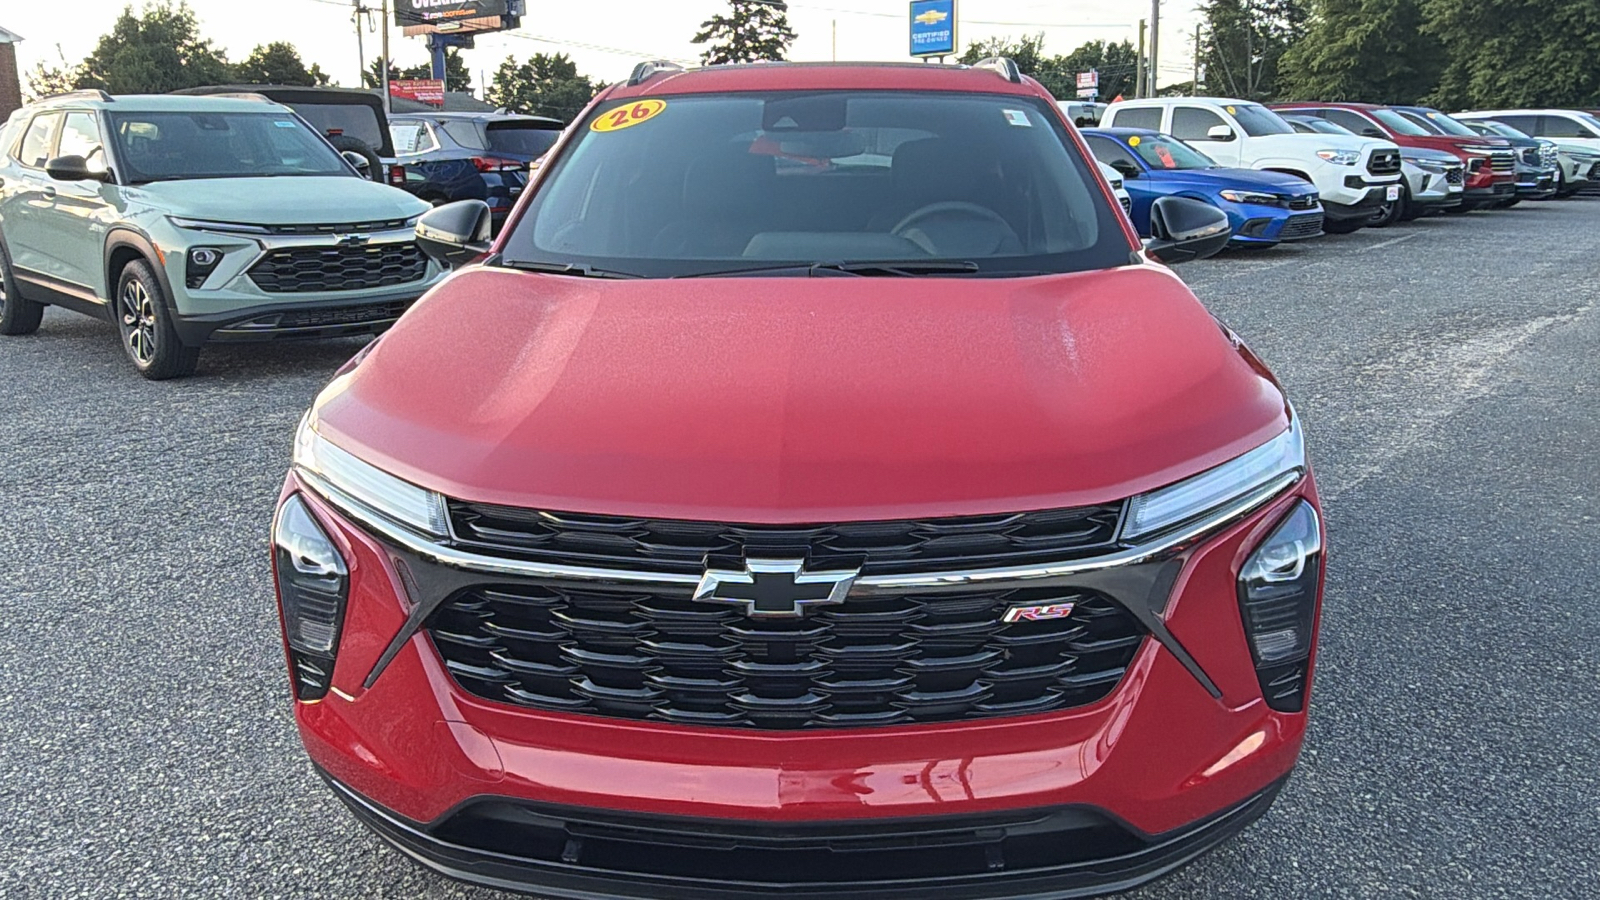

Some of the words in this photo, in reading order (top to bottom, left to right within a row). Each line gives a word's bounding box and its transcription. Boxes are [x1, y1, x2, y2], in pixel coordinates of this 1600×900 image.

[912, 30, 950, 39] CERTIFIED
[609, 103, 650, 127] 26
[1003, 602, 1075, 623] RS
